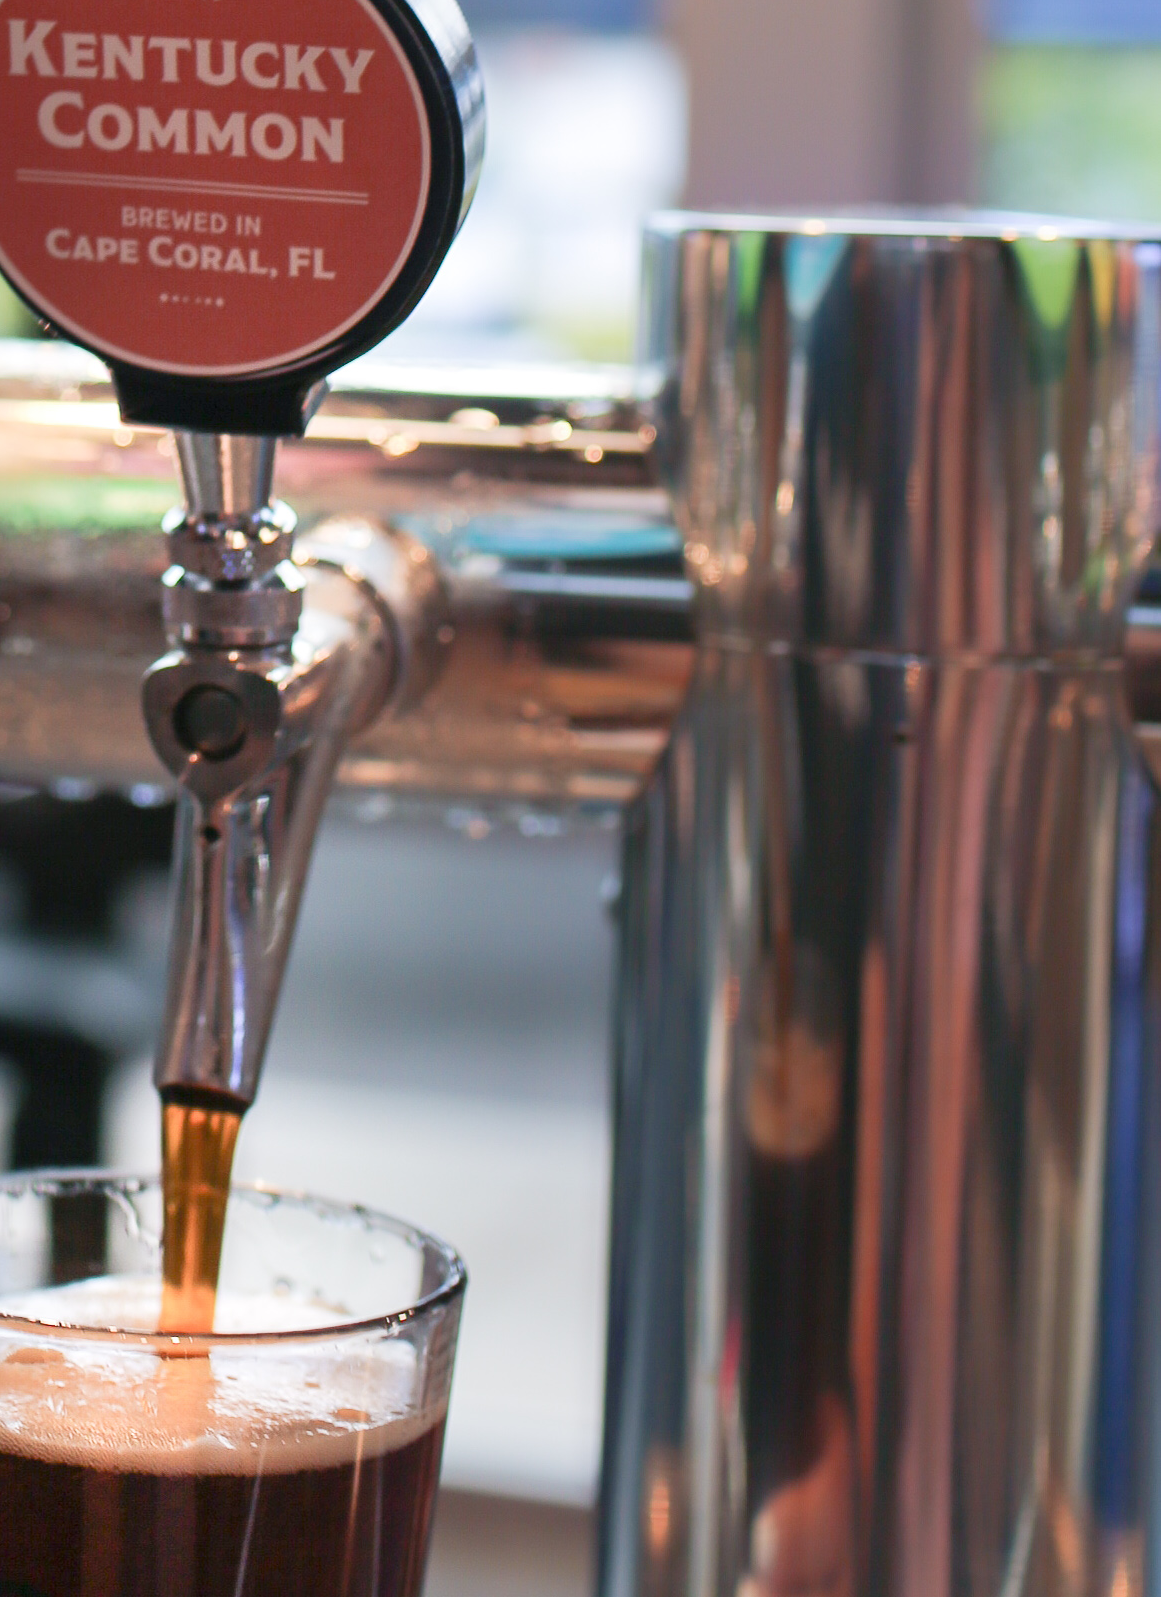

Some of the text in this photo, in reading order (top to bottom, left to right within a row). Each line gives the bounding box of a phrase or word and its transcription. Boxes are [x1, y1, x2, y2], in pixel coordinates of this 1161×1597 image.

[7, 19, 375, 94] KENTUCKY
[38, 92, 345, 163] COMMON
[121, 205, 262, 238] BREWED IN
[45, 228, 336, 281] CAPE CORAL, FL
